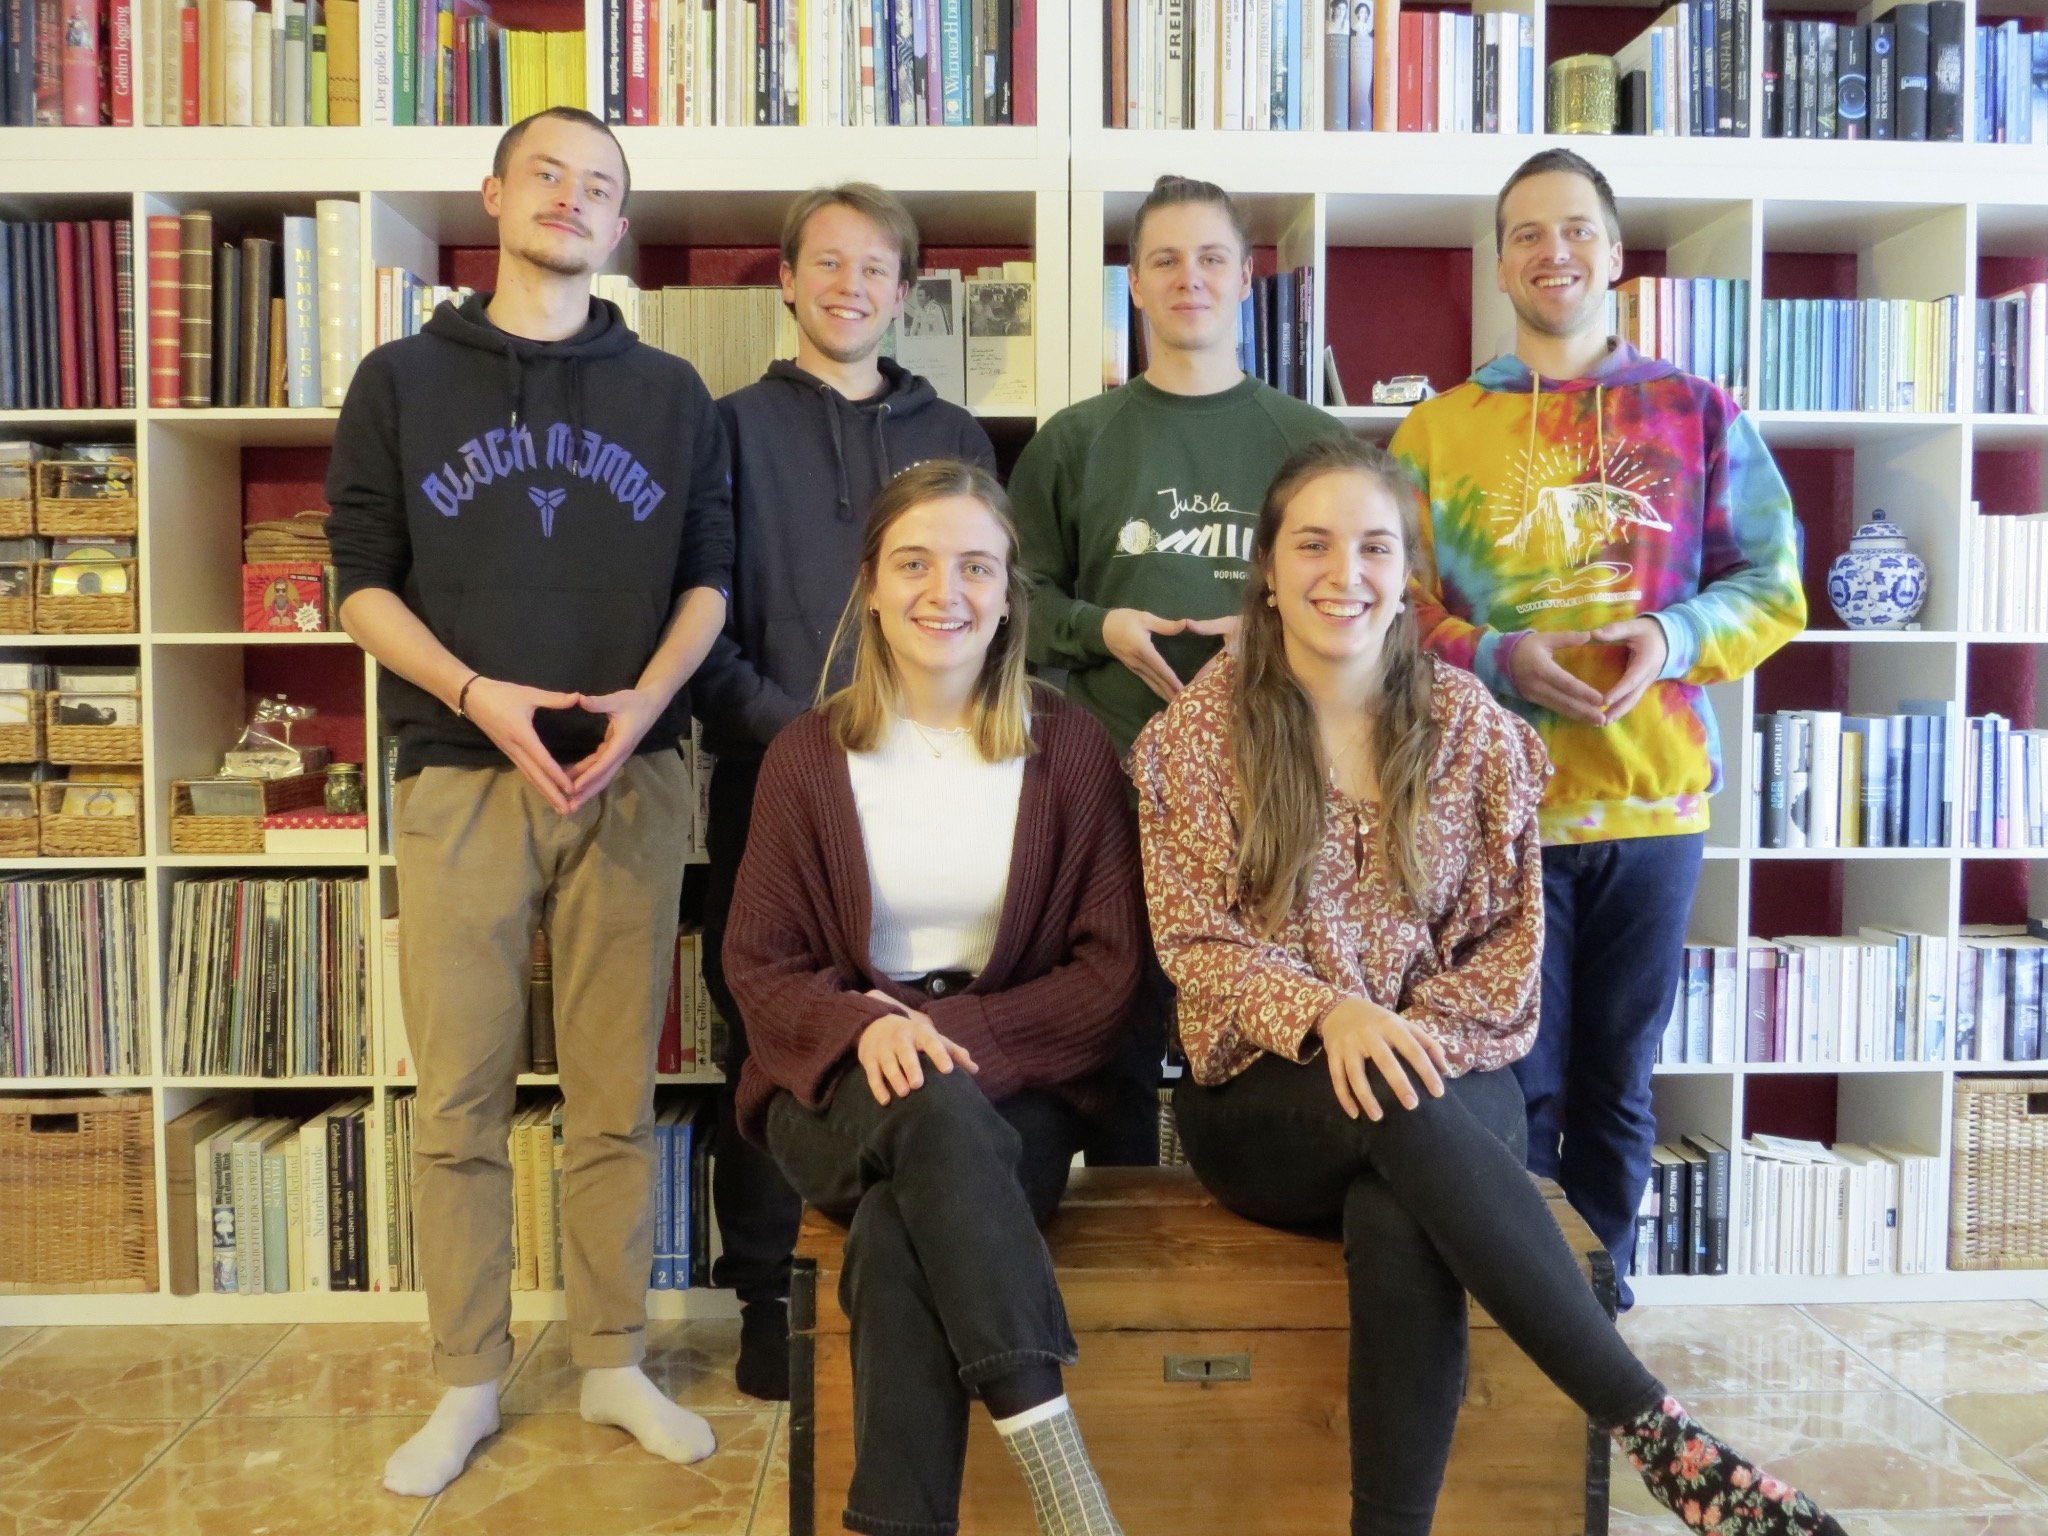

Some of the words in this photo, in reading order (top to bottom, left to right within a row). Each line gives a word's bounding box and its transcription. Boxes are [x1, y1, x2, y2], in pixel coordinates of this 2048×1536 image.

[114, 6, 131, 51] Jogging
[374, 33, 388, 48] IQ
[115, 53, 130, 96] Gehirn
[374, 51, 390, 86] große
[632, 36, 644, 78] wirklich?
[1720, 30, 1732, 94] WHISKY
[374, 88, 386, 110] Der
[294, 247, 314, 379] MEMORIES
[1774, 744, 1782, 776] OPFER
[1983, 742, 1992, 799] FLORIDA
[312, 1146, 324, 1238] Naturheilkunde
[1670, 1170, 1678, 1194] TOWN
[1669, 1196, 1677, 1212] COP
[658, 1270, 667, 1284] 2
[676, 1270, 685, 1284] 3
